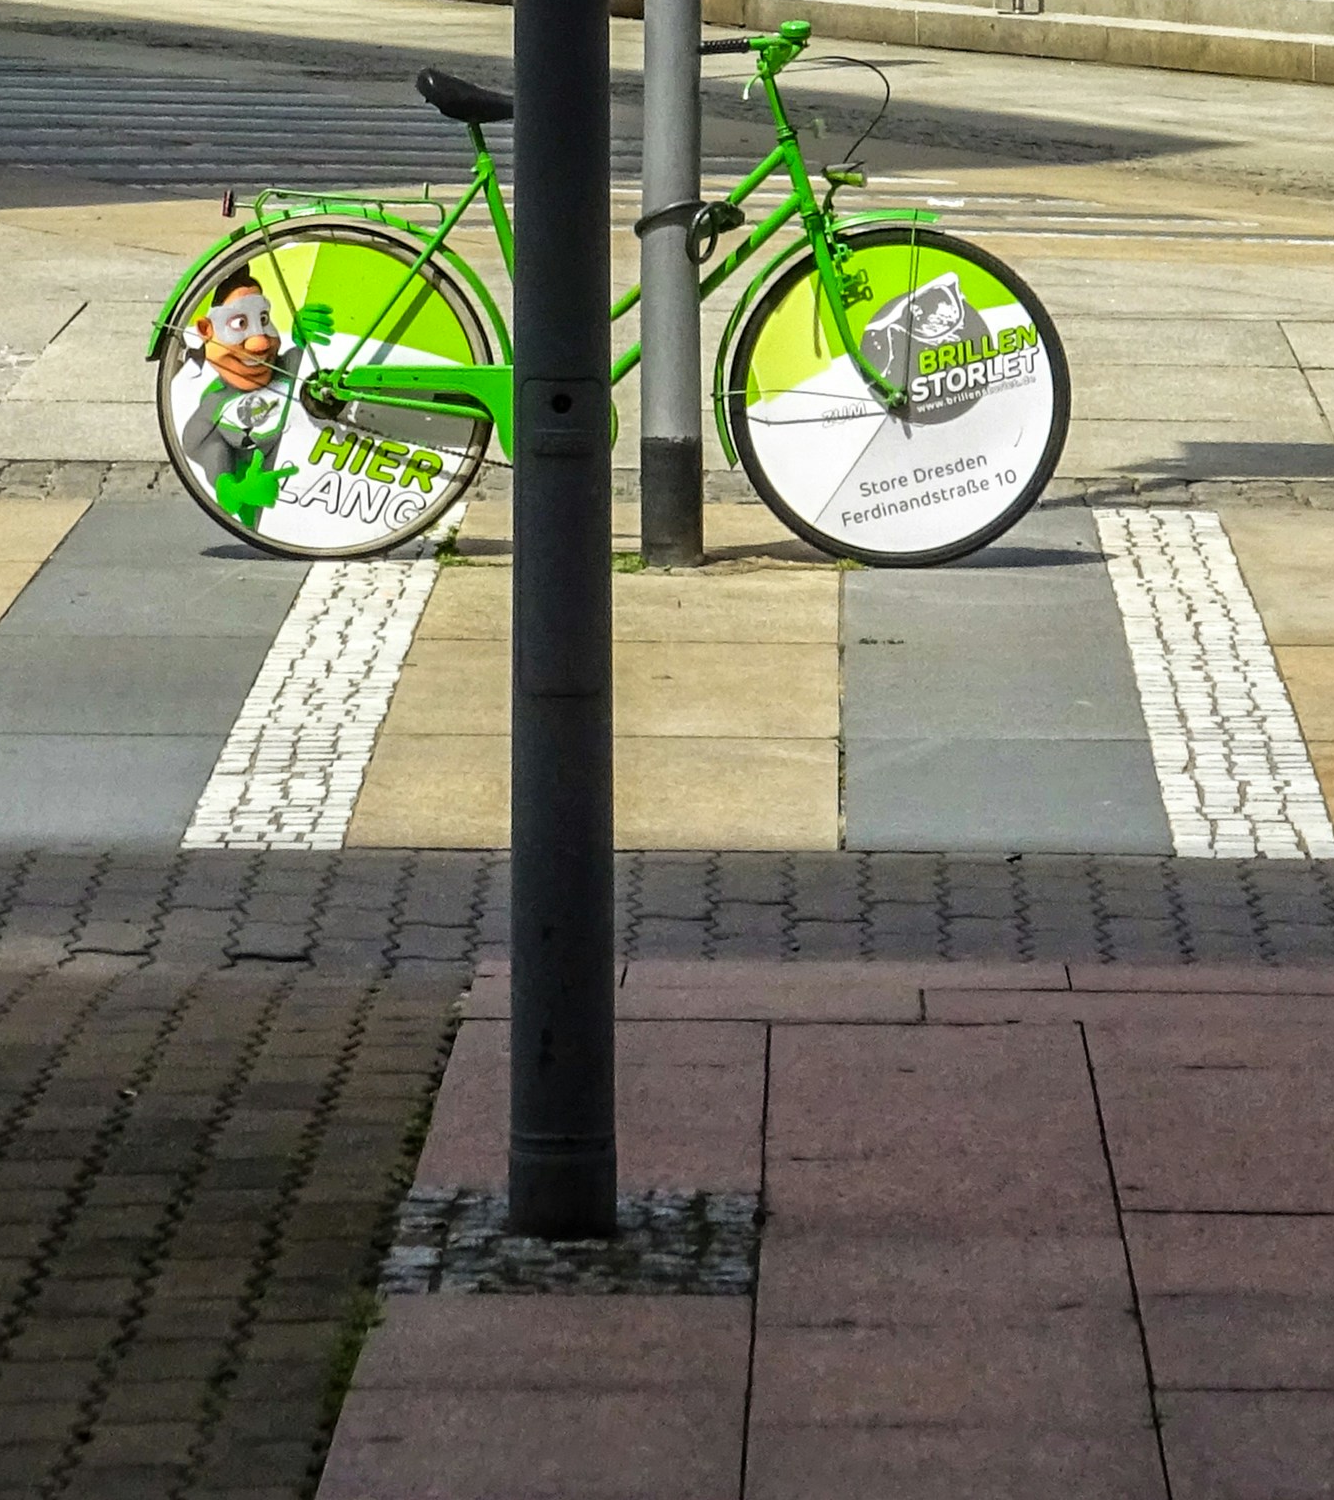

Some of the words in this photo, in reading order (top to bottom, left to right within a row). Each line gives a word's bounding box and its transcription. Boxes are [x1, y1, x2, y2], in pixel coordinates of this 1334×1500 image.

[911, 347, 1040, 403] STORLET
[919, 323, 1039, 375] BRILLEN
[308, 426, 443, 493] HIER
[859, 473, 908, 498] Store
[913, 454, 987, 484] Dresden
[276, 460, 427, 531] LANG
[841, 478, 990, 527] Ferdinandstraße
[994, 468, 1017, 487] 10
